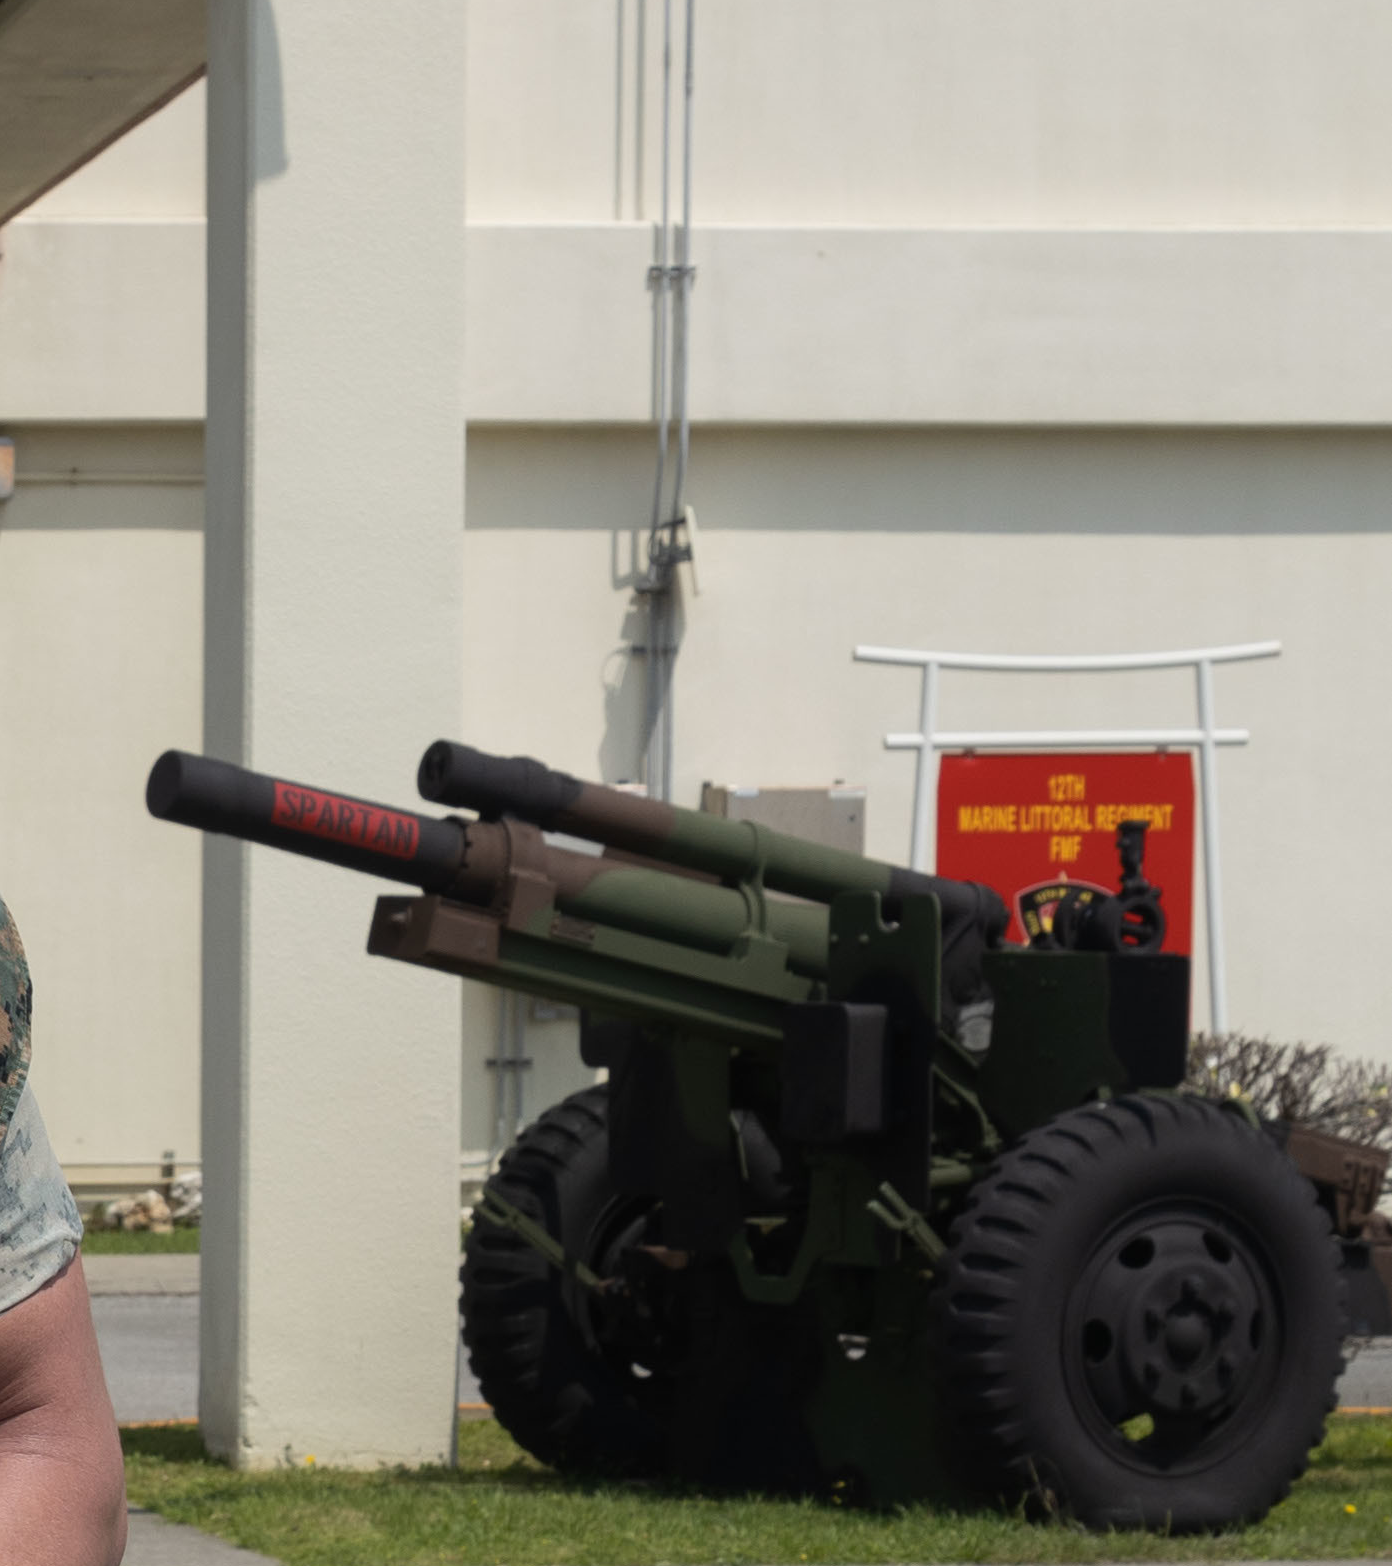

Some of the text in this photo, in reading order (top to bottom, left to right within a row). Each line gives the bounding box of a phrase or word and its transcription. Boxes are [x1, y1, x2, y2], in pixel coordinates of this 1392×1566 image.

[1048, 773, 1085, 802] 12TH
[279, 789, 415, 855] SPARTAN
[958, 805, 1017, 832] MARINE
[1020, 805, 1092, 832] LITTORAL
[1049, 836, 1081, 863] FMF
